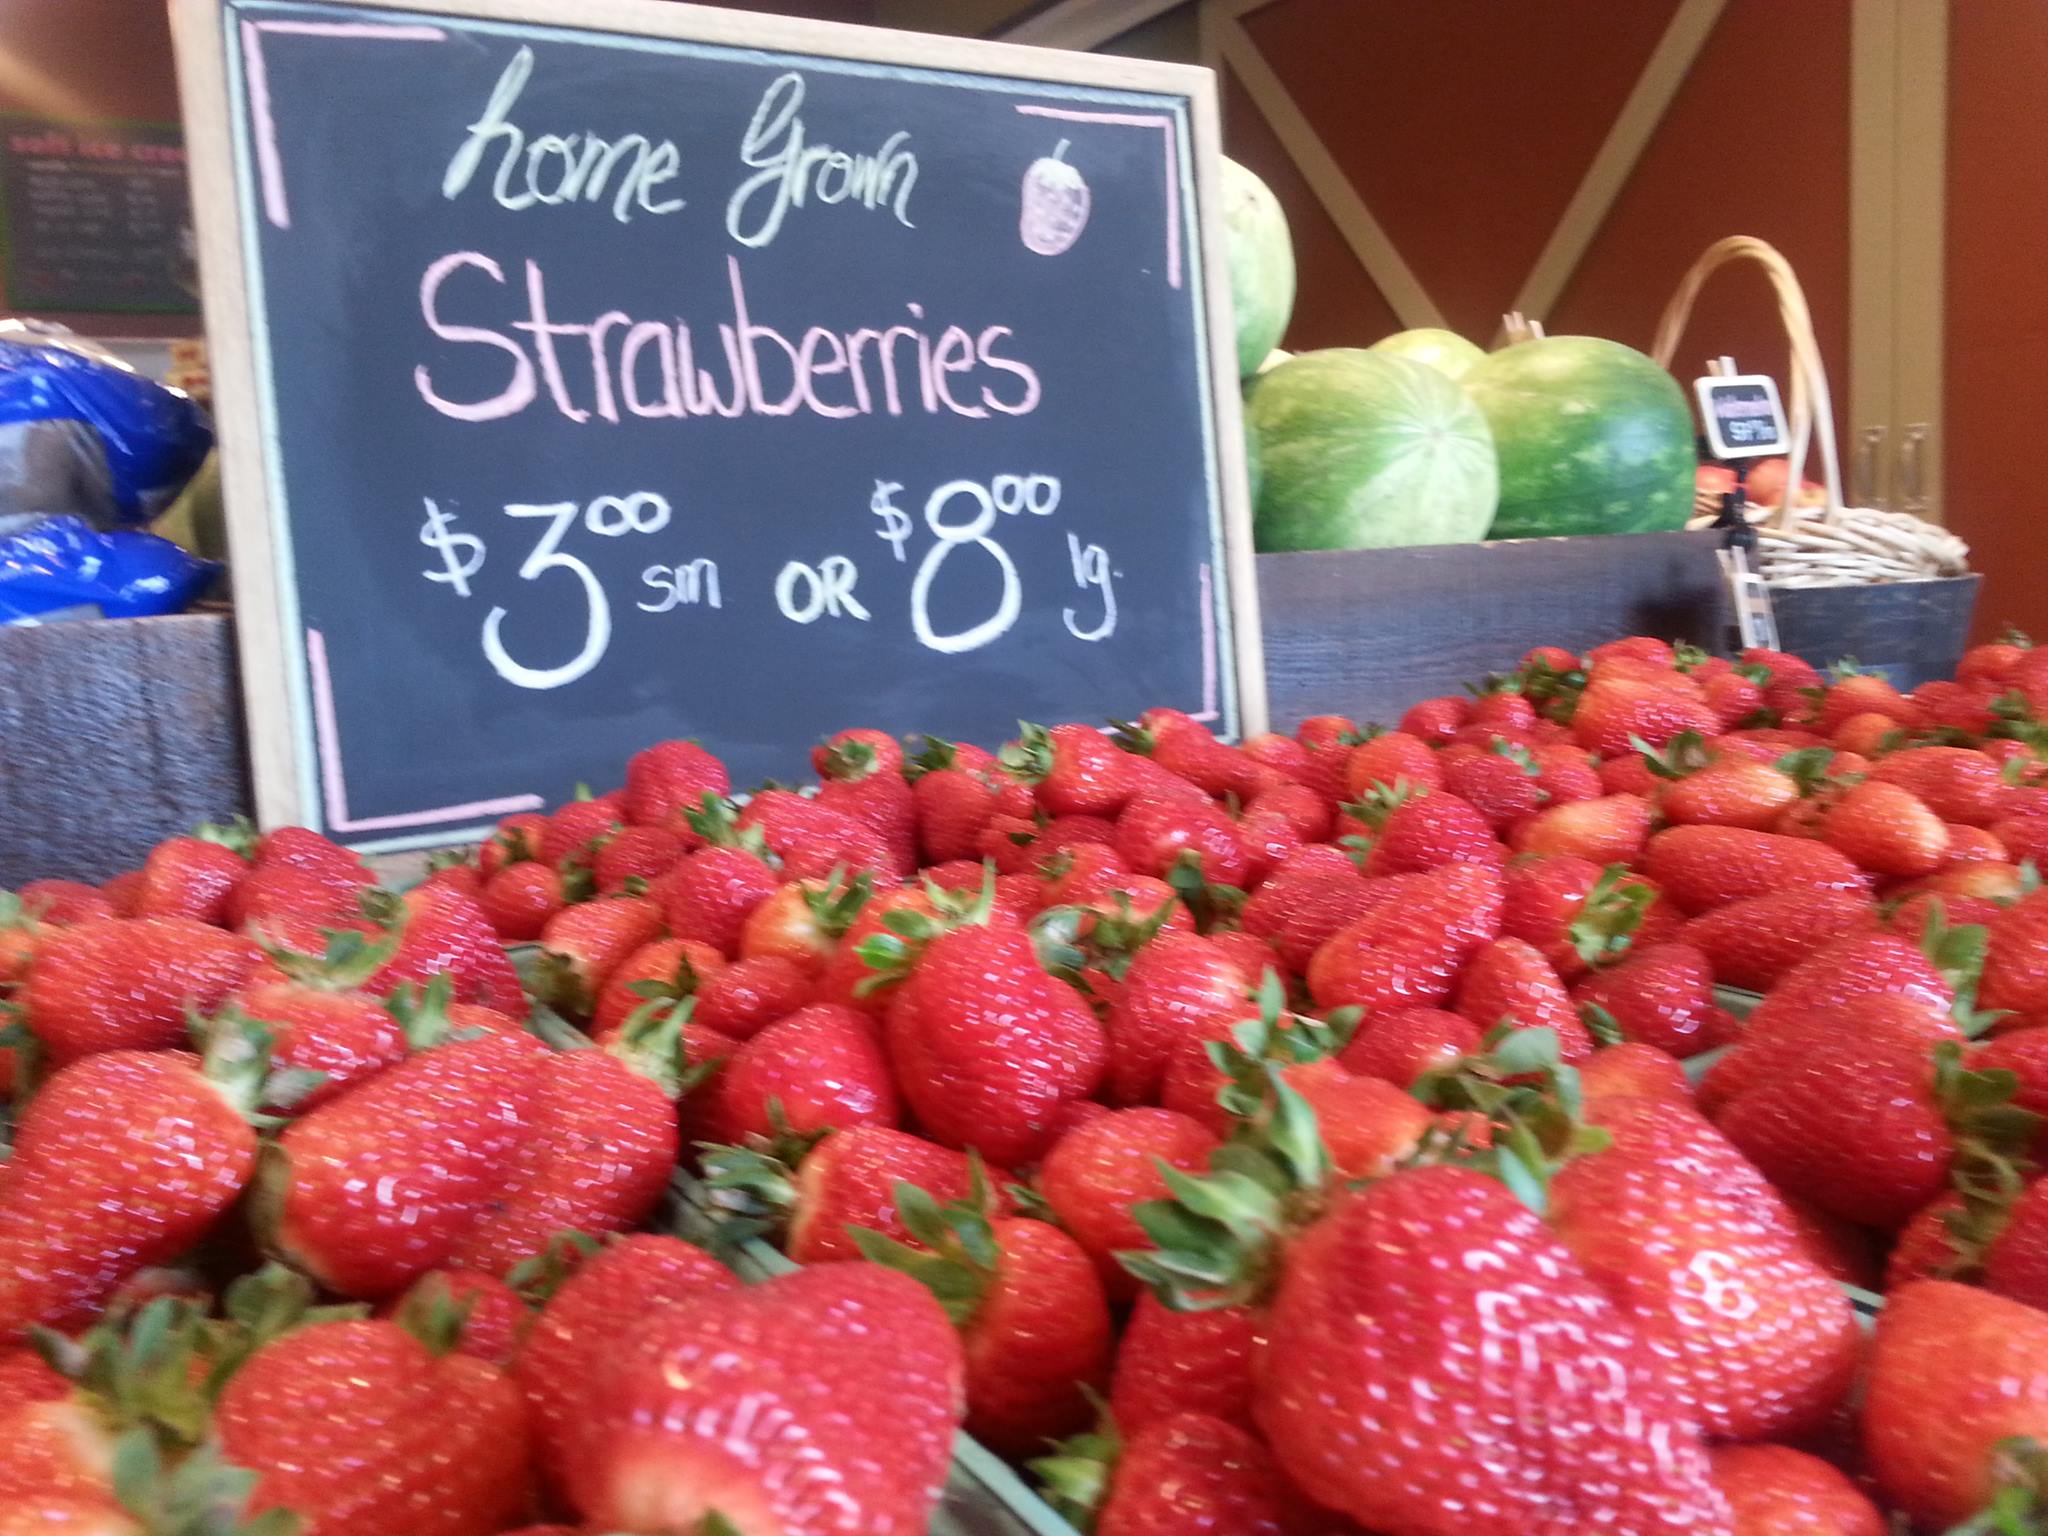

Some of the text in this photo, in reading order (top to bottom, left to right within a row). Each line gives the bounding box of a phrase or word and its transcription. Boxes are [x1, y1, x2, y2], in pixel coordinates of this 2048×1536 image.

[441, 45, 687, 224] home
[414, 250, 1041, 424] Strawberries
[775, 555, 871, 624] OR
